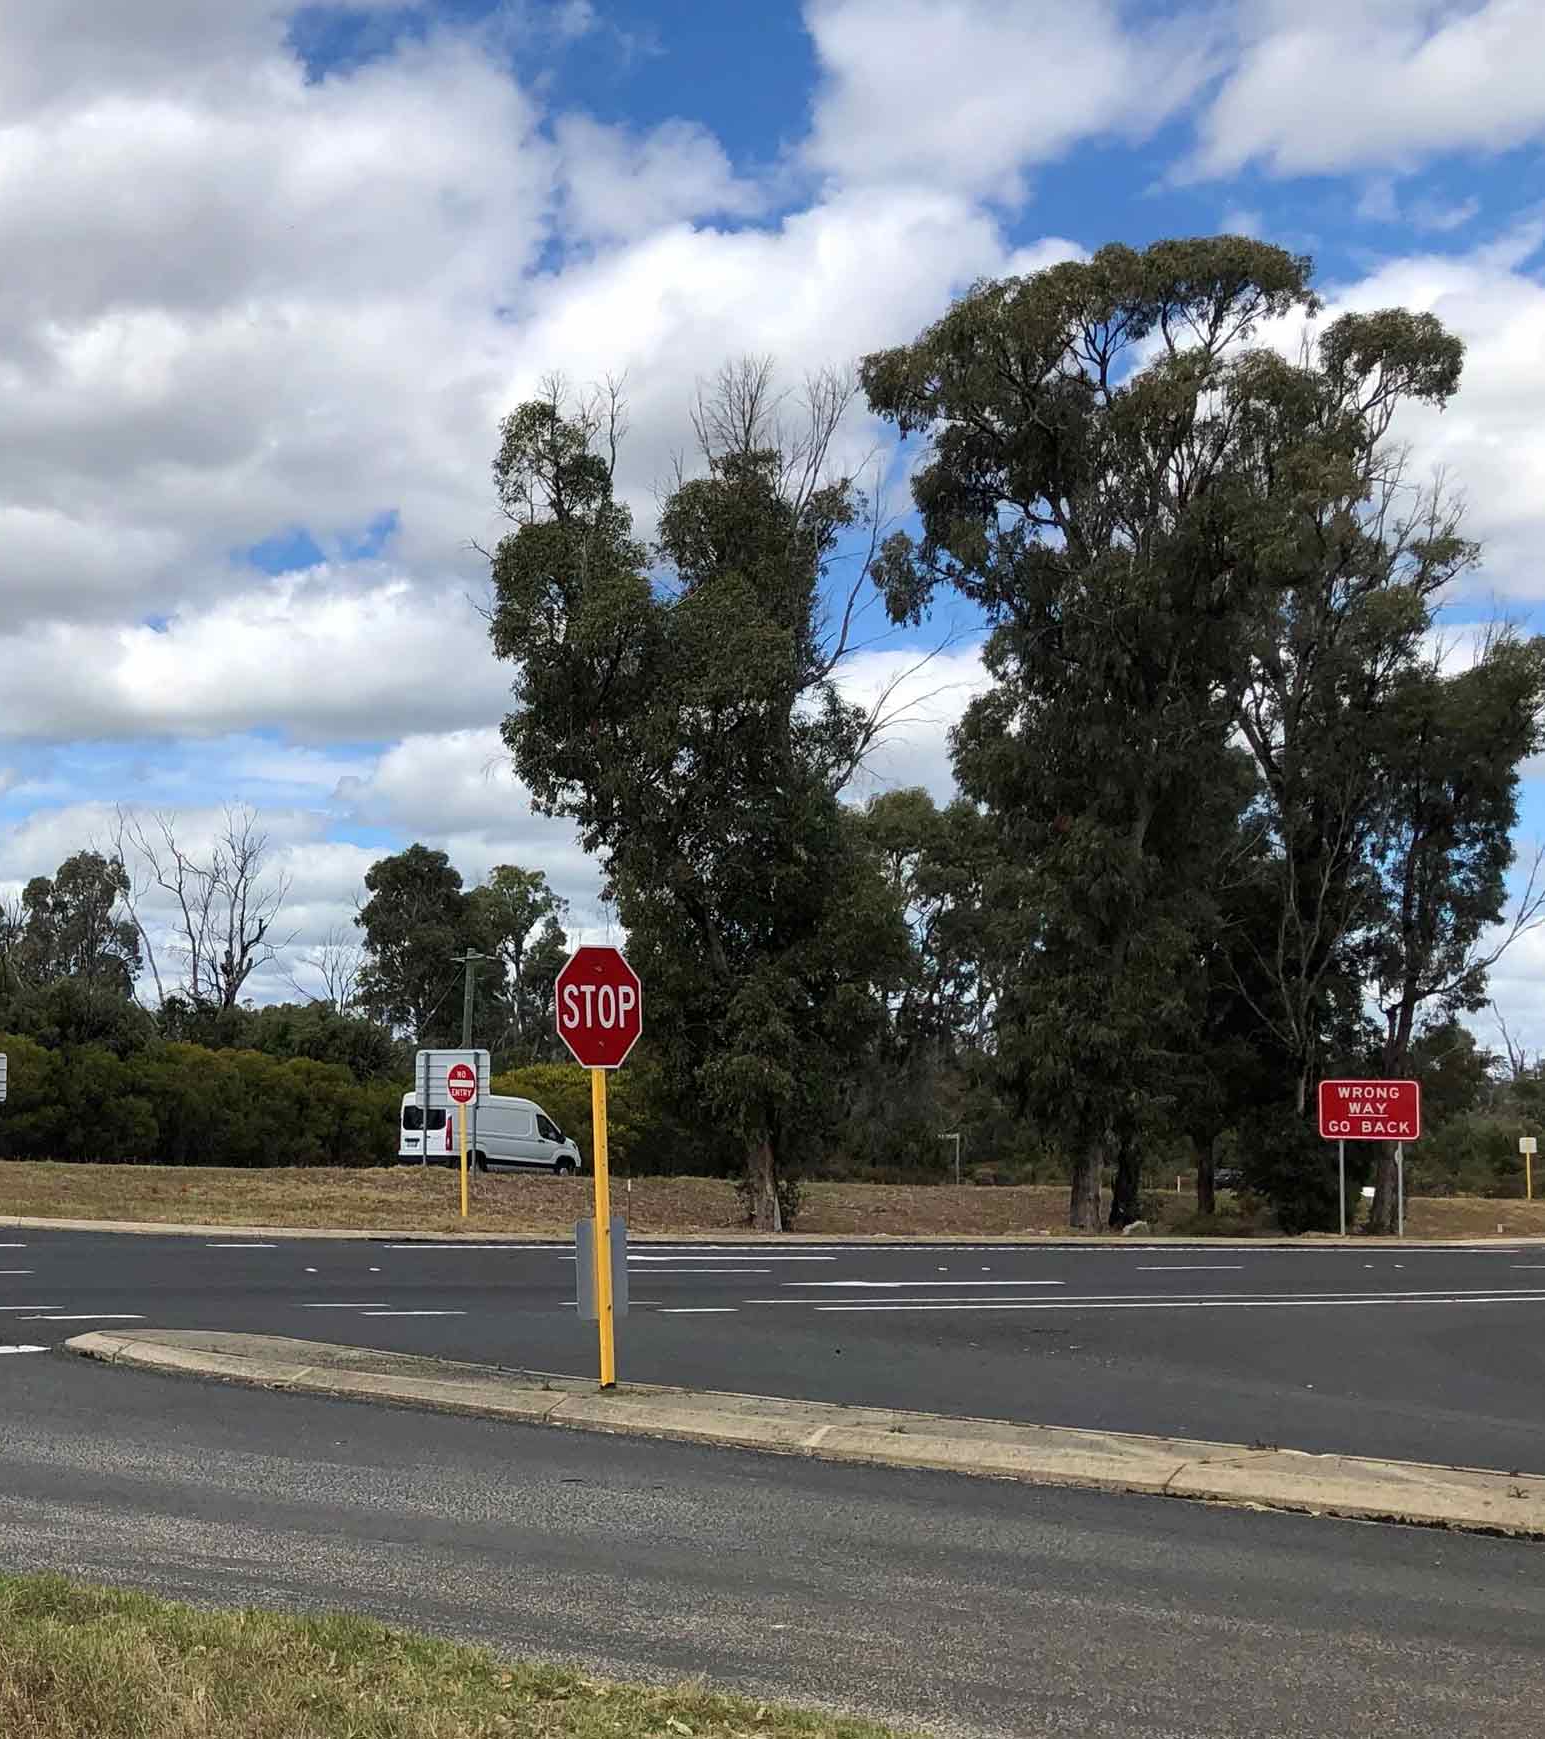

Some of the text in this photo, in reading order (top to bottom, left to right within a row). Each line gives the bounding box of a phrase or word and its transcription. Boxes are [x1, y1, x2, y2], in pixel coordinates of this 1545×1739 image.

[563, 984, 635, 1028] STOP
[456, 1070, 467, 1079] NO
[451, 1088, 472, 1097] ENTRY
[1338, 1086, 1400, 1099] WRONG
[1348, 1102, 1388, 1114] WAY
[1328, 1120, 1410, 1134] GO BACK
